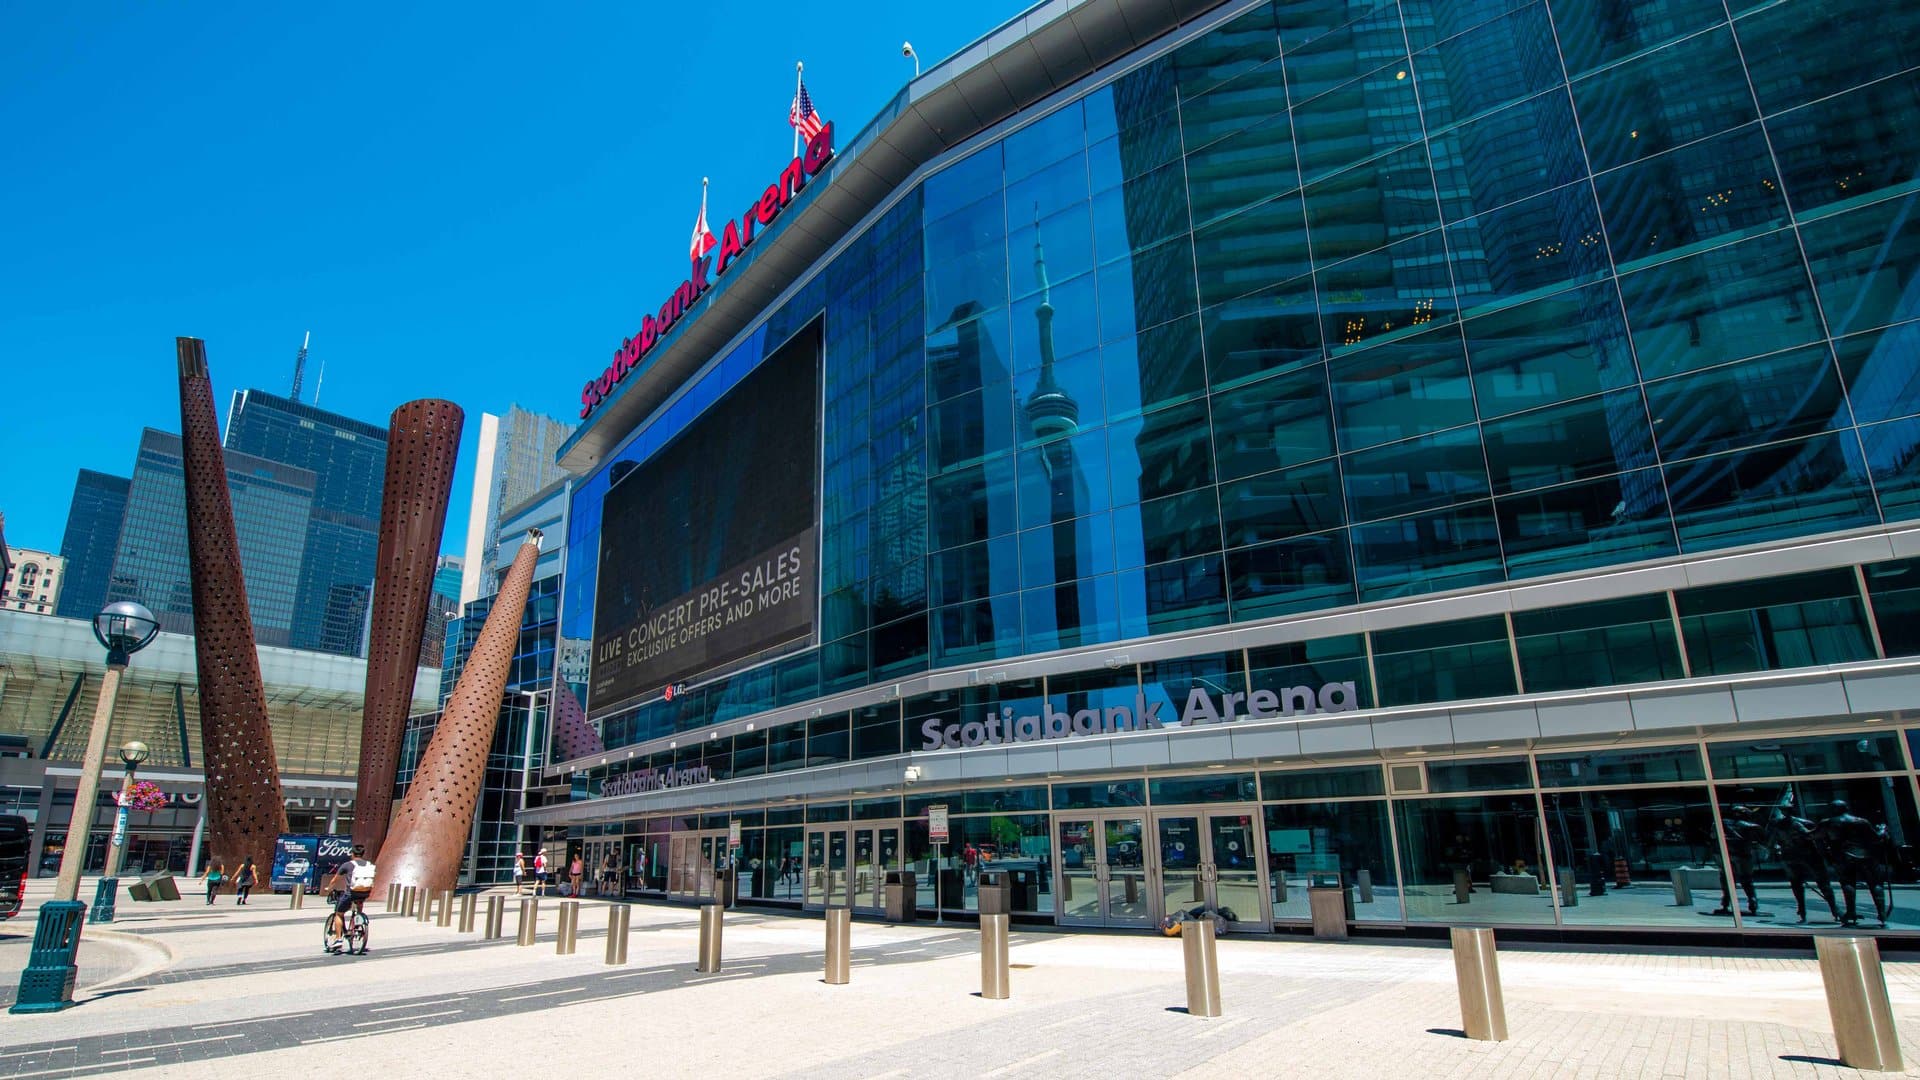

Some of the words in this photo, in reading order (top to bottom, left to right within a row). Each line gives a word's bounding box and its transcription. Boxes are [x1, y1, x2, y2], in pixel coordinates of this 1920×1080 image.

[580, 256, 711, 419] Scotiabank
[716, 120, 835, 276] Arena
[626, 632, 677, 667] EXCLUSIVE
[679, 612, 722, 645] OFFERS
[726, 598, 754, 625] AND
[758, 576, 801, 611] MORE
[627, 599, 694, 649] CONCERT
[699, 546, 801, 616] PRE-SALES
[599, 636, 622, 663] LIVE
[921, 692, 1164, 751] Scotiabank
[1181, 680, 1358, 726] Arena
[600, 768, 663, 798] Scotiabank
[665, 765, 709, 788] Arena
